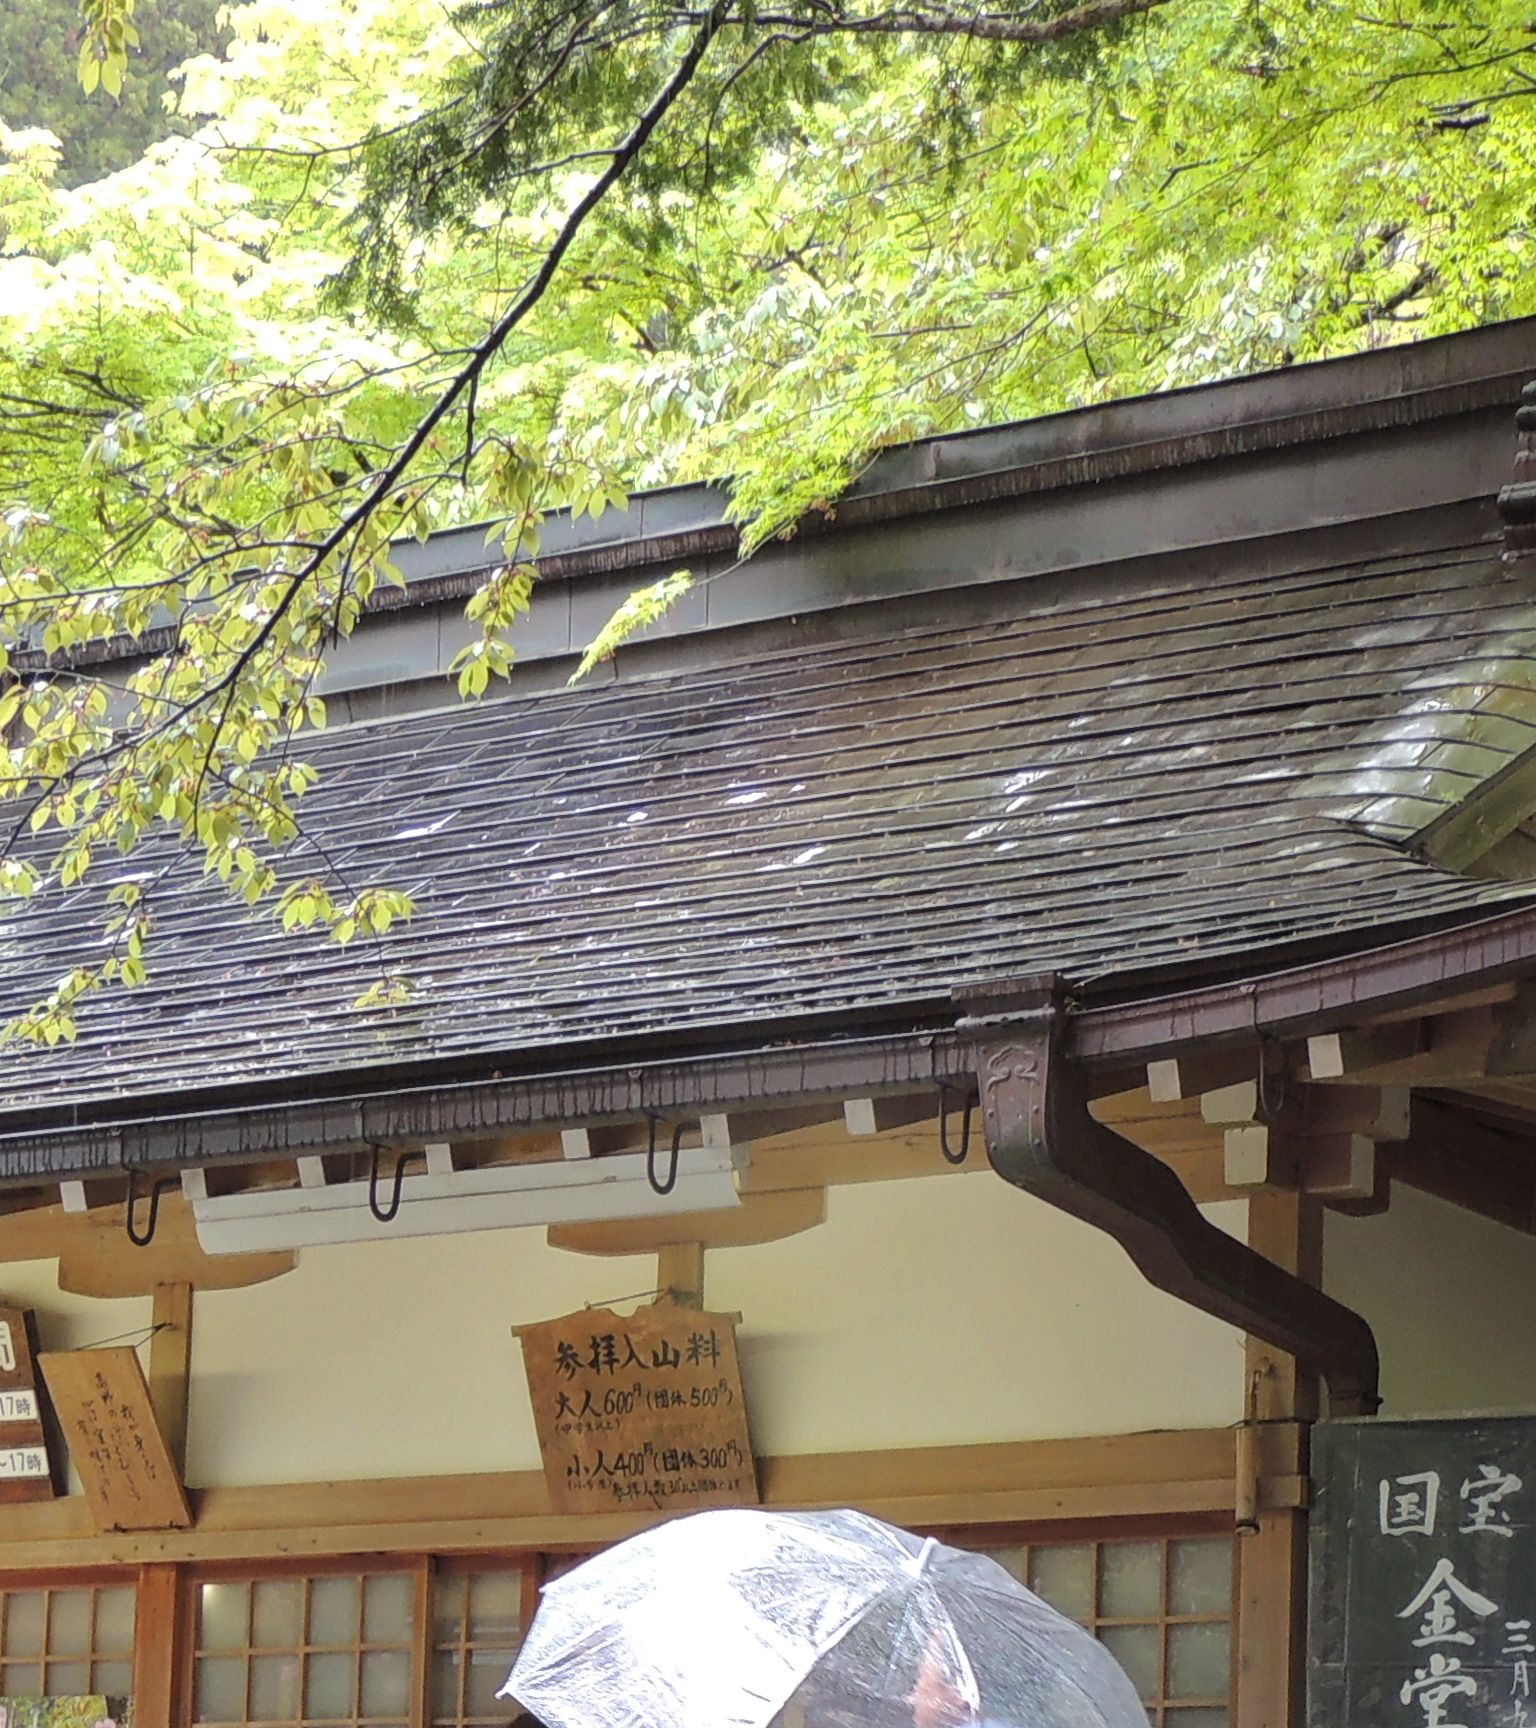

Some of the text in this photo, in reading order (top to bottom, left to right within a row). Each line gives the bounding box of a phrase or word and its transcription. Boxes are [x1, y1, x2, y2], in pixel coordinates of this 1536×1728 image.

[554, 1329, 720, 1381] 参拝入山料
[1378, 1464, 1523, 1538] 国宝
